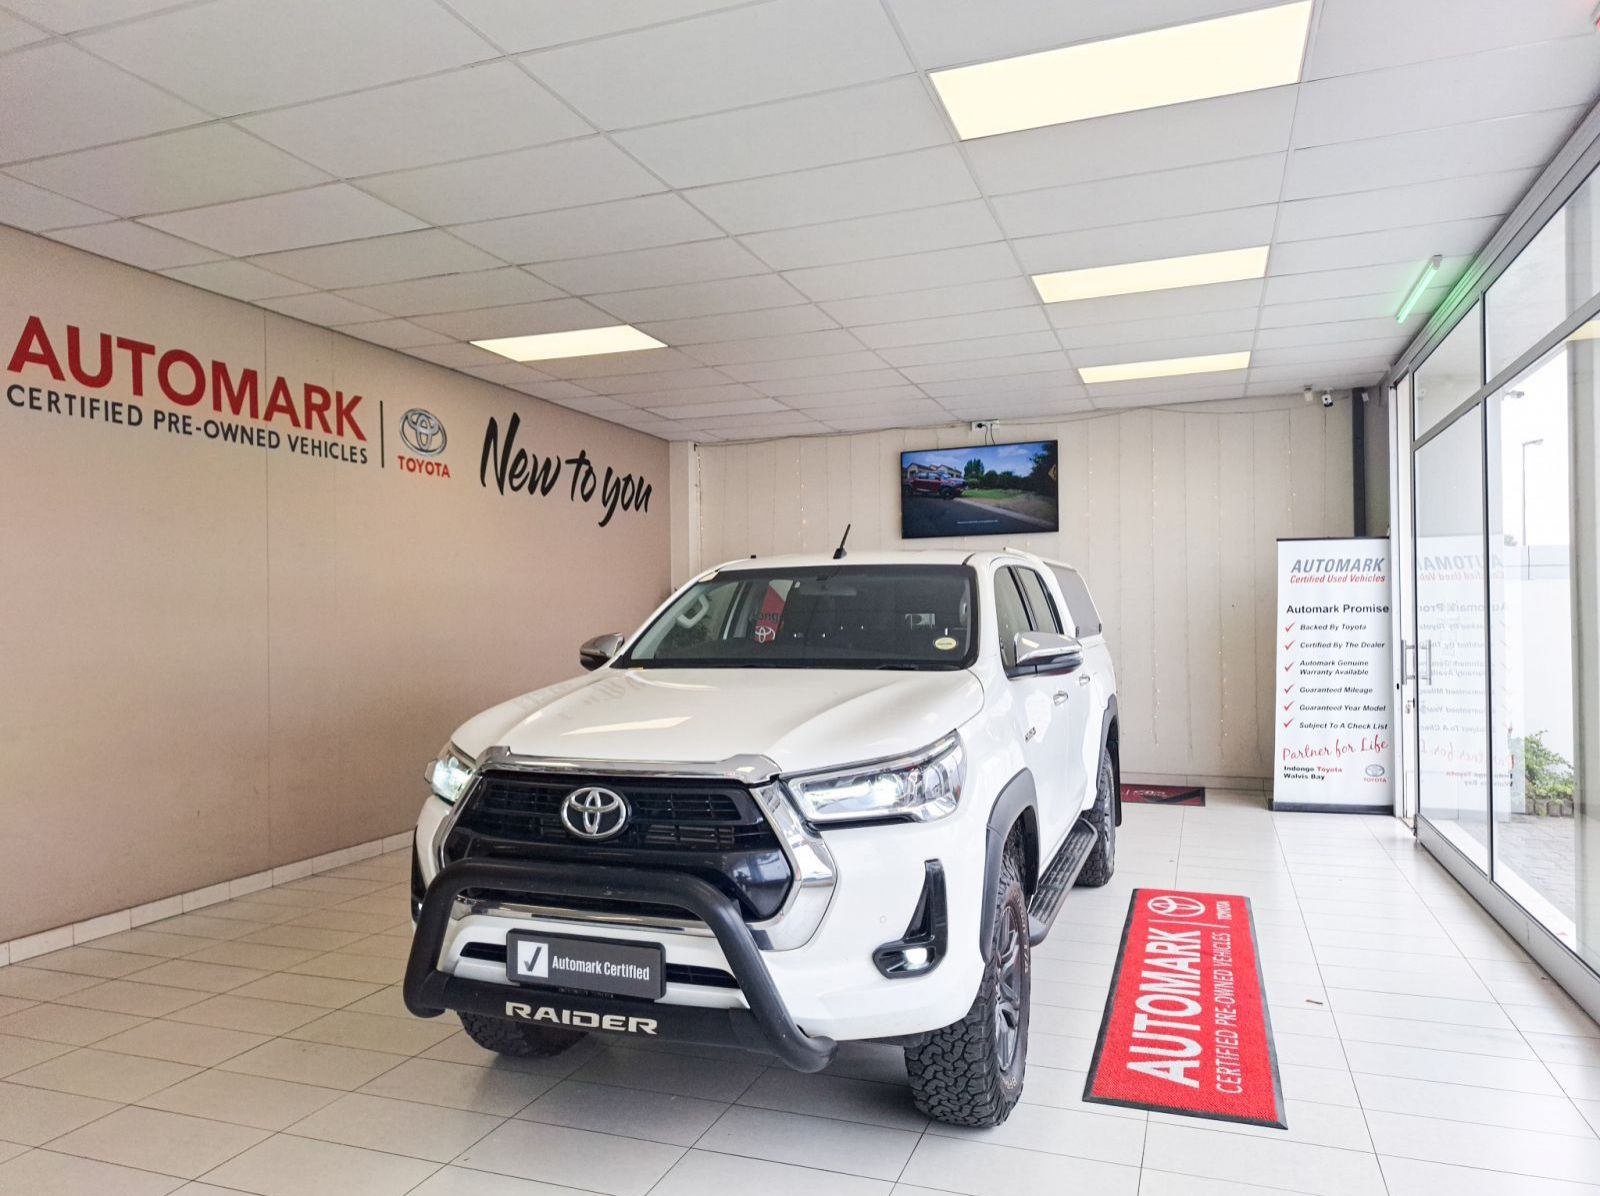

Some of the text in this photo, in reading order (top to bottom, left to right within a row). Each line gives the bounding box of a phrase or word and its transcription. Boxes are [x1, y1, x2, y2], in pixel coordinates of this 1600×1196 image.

[7, 315, 367, 441] AUTOMARK
[6, 384, 368, 465] CERTIFIED PRE-OWNED VEHICLES
[397, 455, 450, 478] TOYOTA
[480, 411, 652, 527] New to you
[1290, 557, 1385, 574] AUTOMARK
[1290, 573, 1386, 583] Certified Used Vehicles
[1286, 603, 1390, 614] Automark Promise
[1330, 624, 1339, 632] By
[1342, 623, 1367, 632] Toyota
[1300, 641, 1332, 649] Certified
[1334, 642, 1343, 650] By
[1299, 722, 1327, 730] Subject
[1282, 734, 1388, 761] Partner for Life
[1316, 766, 1342, 774] Toyota
[1216, 900, 1233, 921] TOYOTA
[552, 955, 650, 981] Automark Certified
[505, 1001, 658, 1035] RAIDER
[1126, 927, 1203, 1089] AUTOMARK
[1212, 931, 1243, 1095] CERTIFIED PRE-OWNED VEHICLES
